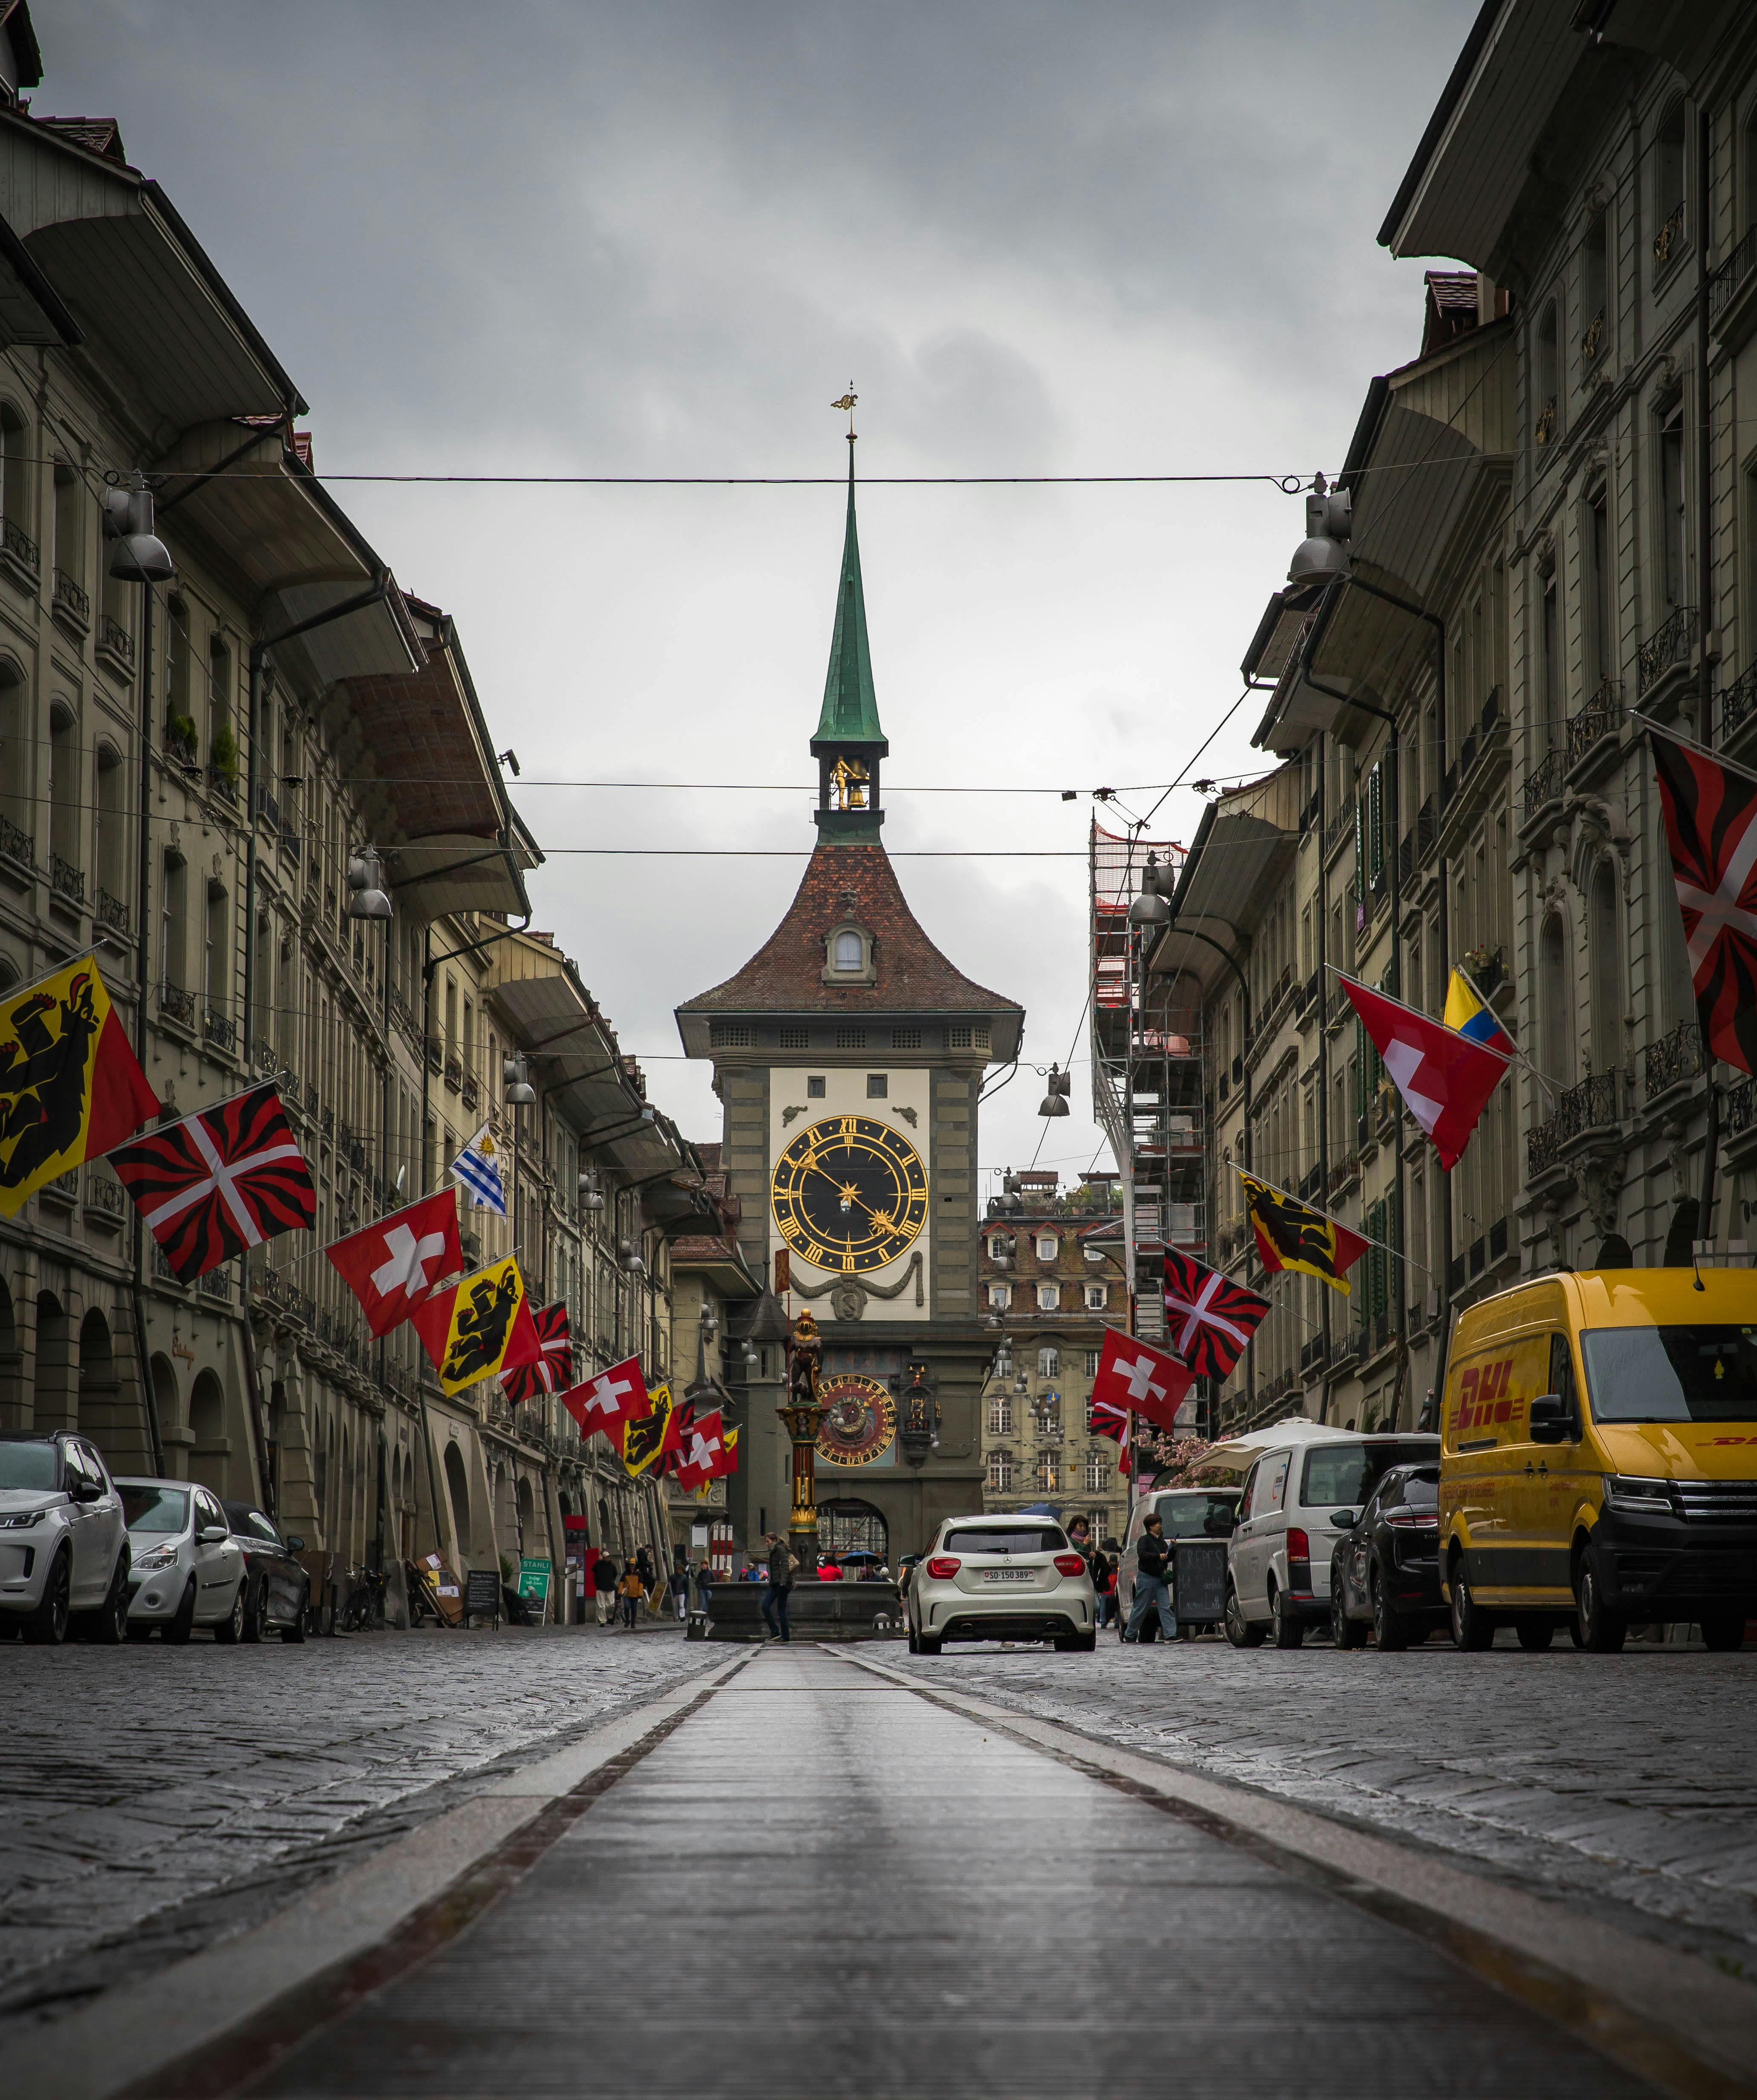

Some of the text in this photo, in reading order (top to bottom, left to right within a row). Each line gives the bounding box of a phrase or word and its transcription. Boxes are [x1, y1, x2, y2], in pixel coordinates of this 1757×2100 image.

[839, 1119, 857, 1133] XII
[807, 1128, 822, 1146] XI
[879, 1128, 888, 1142] I
[783, 1153, 797, 1168] X
[902, 1152, 917, 1166] II
[774, 1185, 789, 1200] IX
[911, 1188, 926, 1201] III
[900, 1220, 919, 1239] IIII
[1457, 1359, 1513, 1431] DHL
